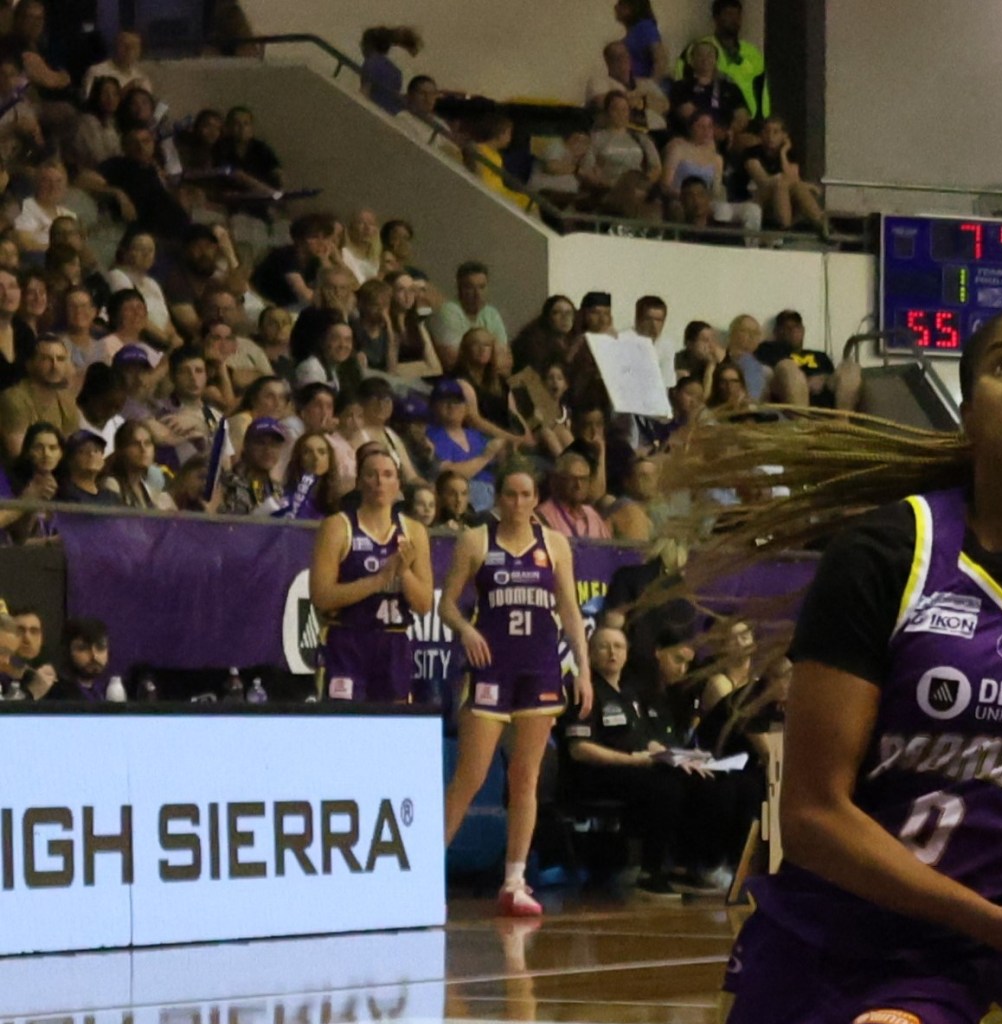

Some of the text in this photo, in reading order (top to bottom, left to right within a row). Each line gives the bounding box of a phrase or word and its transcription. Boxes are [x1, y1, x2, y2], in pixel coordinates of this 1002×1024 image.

[958, 267, 967, 303] 1
[907, 309, 960, 348] 55
[508, 610, 532, 636] 21
[929, 614, 975, 634] IKON
[0, 805, 134, 891] IGH
